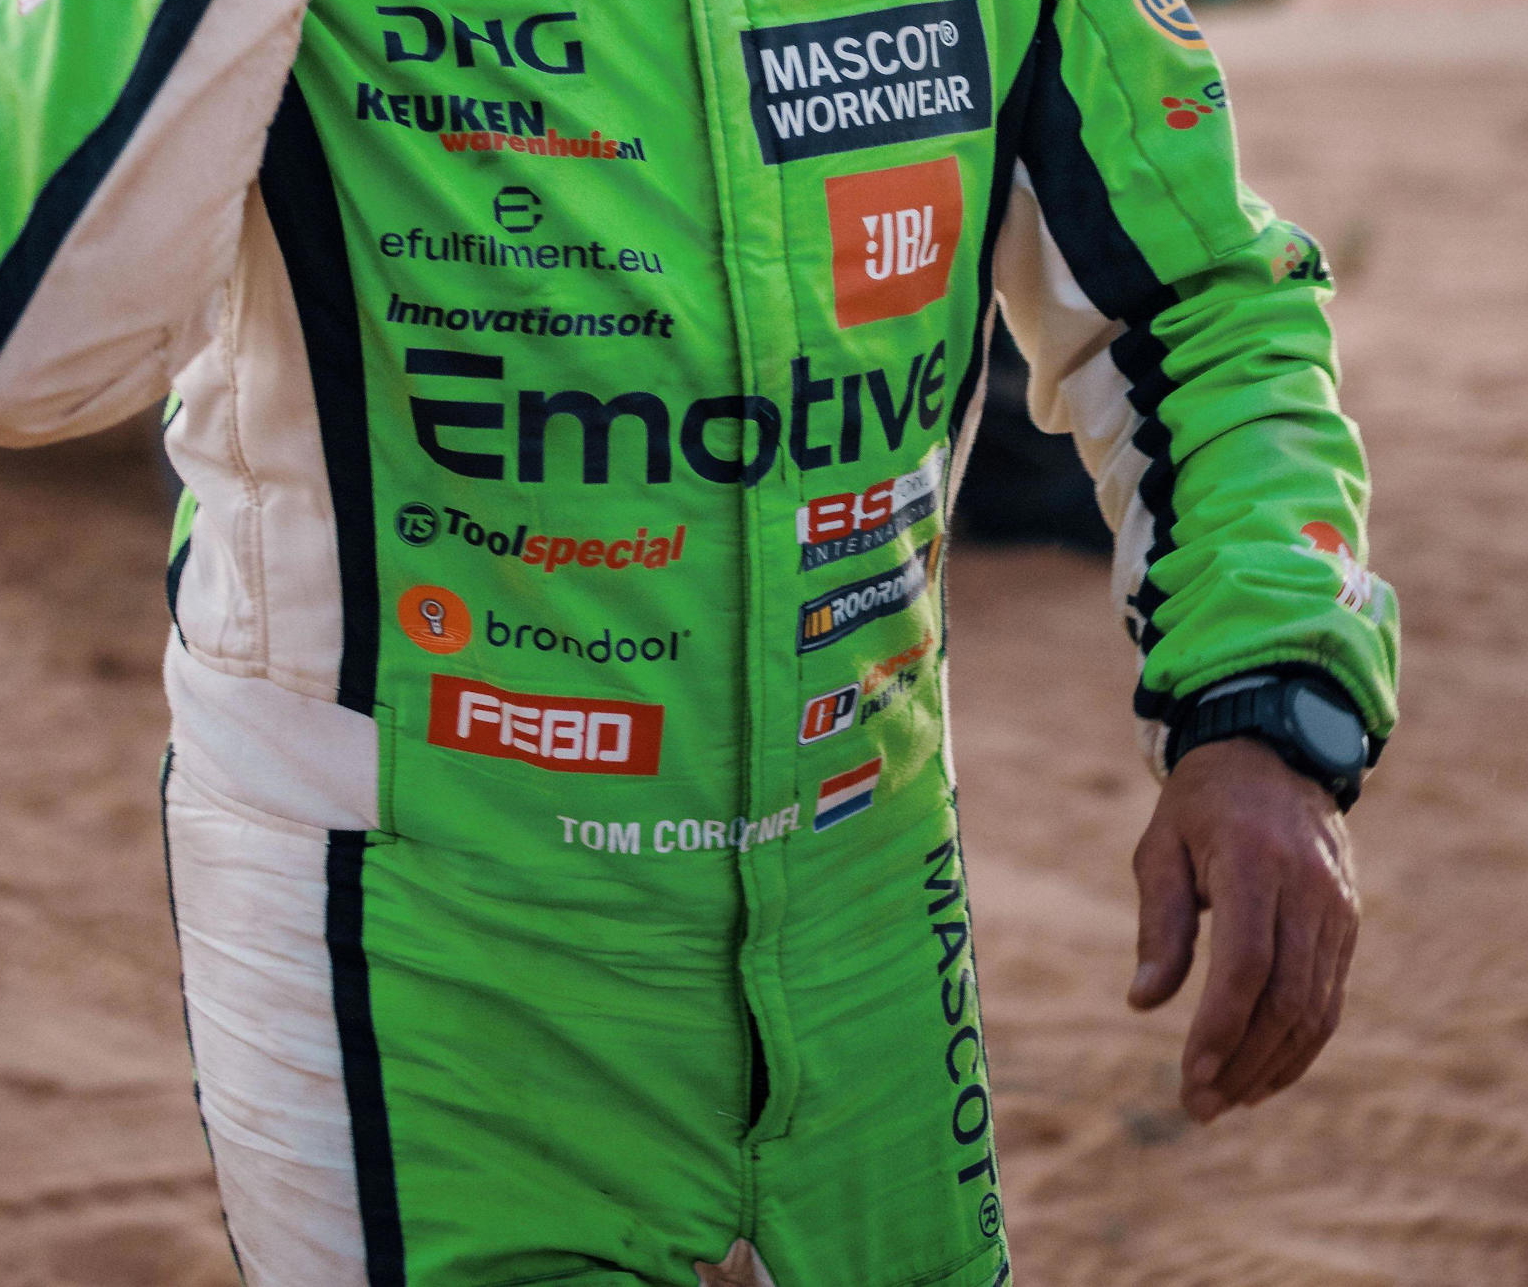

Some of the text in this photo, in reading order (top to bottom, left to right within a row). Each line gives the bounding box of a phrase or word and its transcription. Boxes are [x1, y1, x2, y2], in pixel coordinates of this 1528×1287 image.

[356, 82, 546, 137] KEUKEN
[767, 75, 975, 140] WORKWEAR
[379, 228, 664, 274] efulfilment.eu
[386, 292, 675, 339] Innovationsoft
[405, 340, 946, 487] Emotive
[485, 611, 679, 664] brondool
[456, 690, 632, 762] FEBO
[556, 815, 641, 855] TOM
